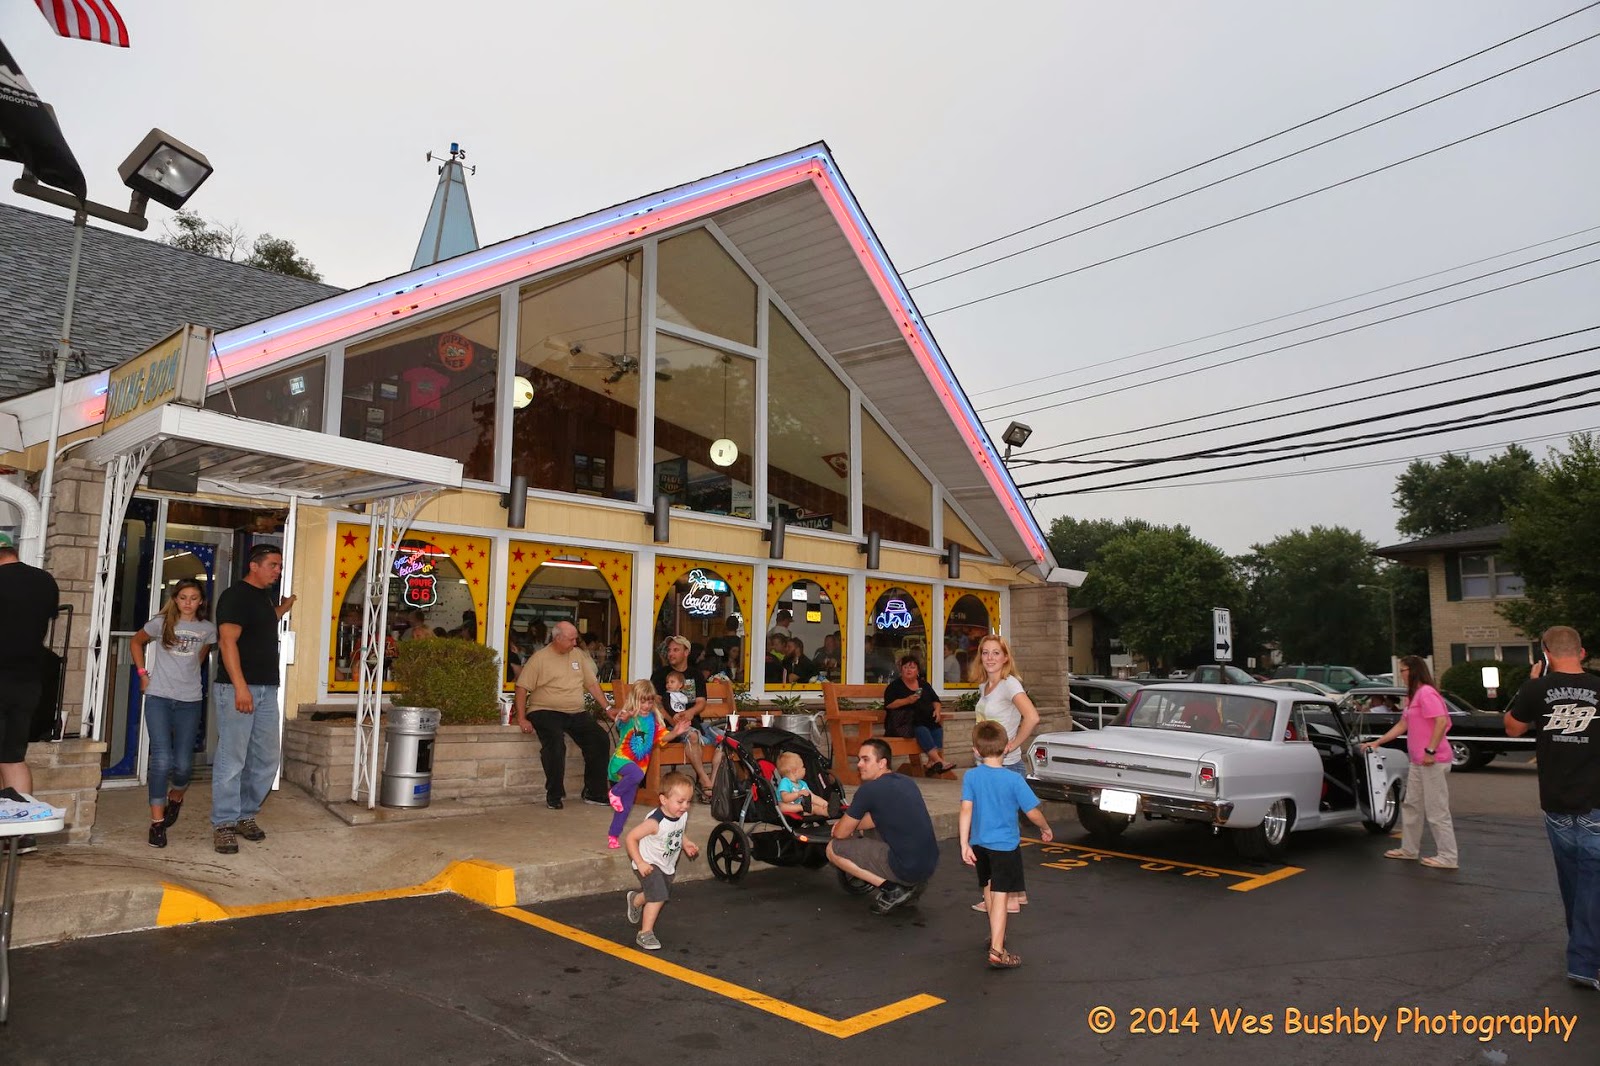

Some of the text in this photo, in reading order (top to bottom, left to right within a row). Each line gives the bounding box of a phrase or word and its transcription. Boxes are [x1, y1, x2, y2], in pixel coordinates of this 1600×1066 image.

[787, 517, 829, 529] ONTIAC
[409, 578, 433, 587] ROUTE
[411, 588, 431, 602] 66
[1218, 613, 1227, 624] ONE
[1218, 625, 1228, 636] WAY
